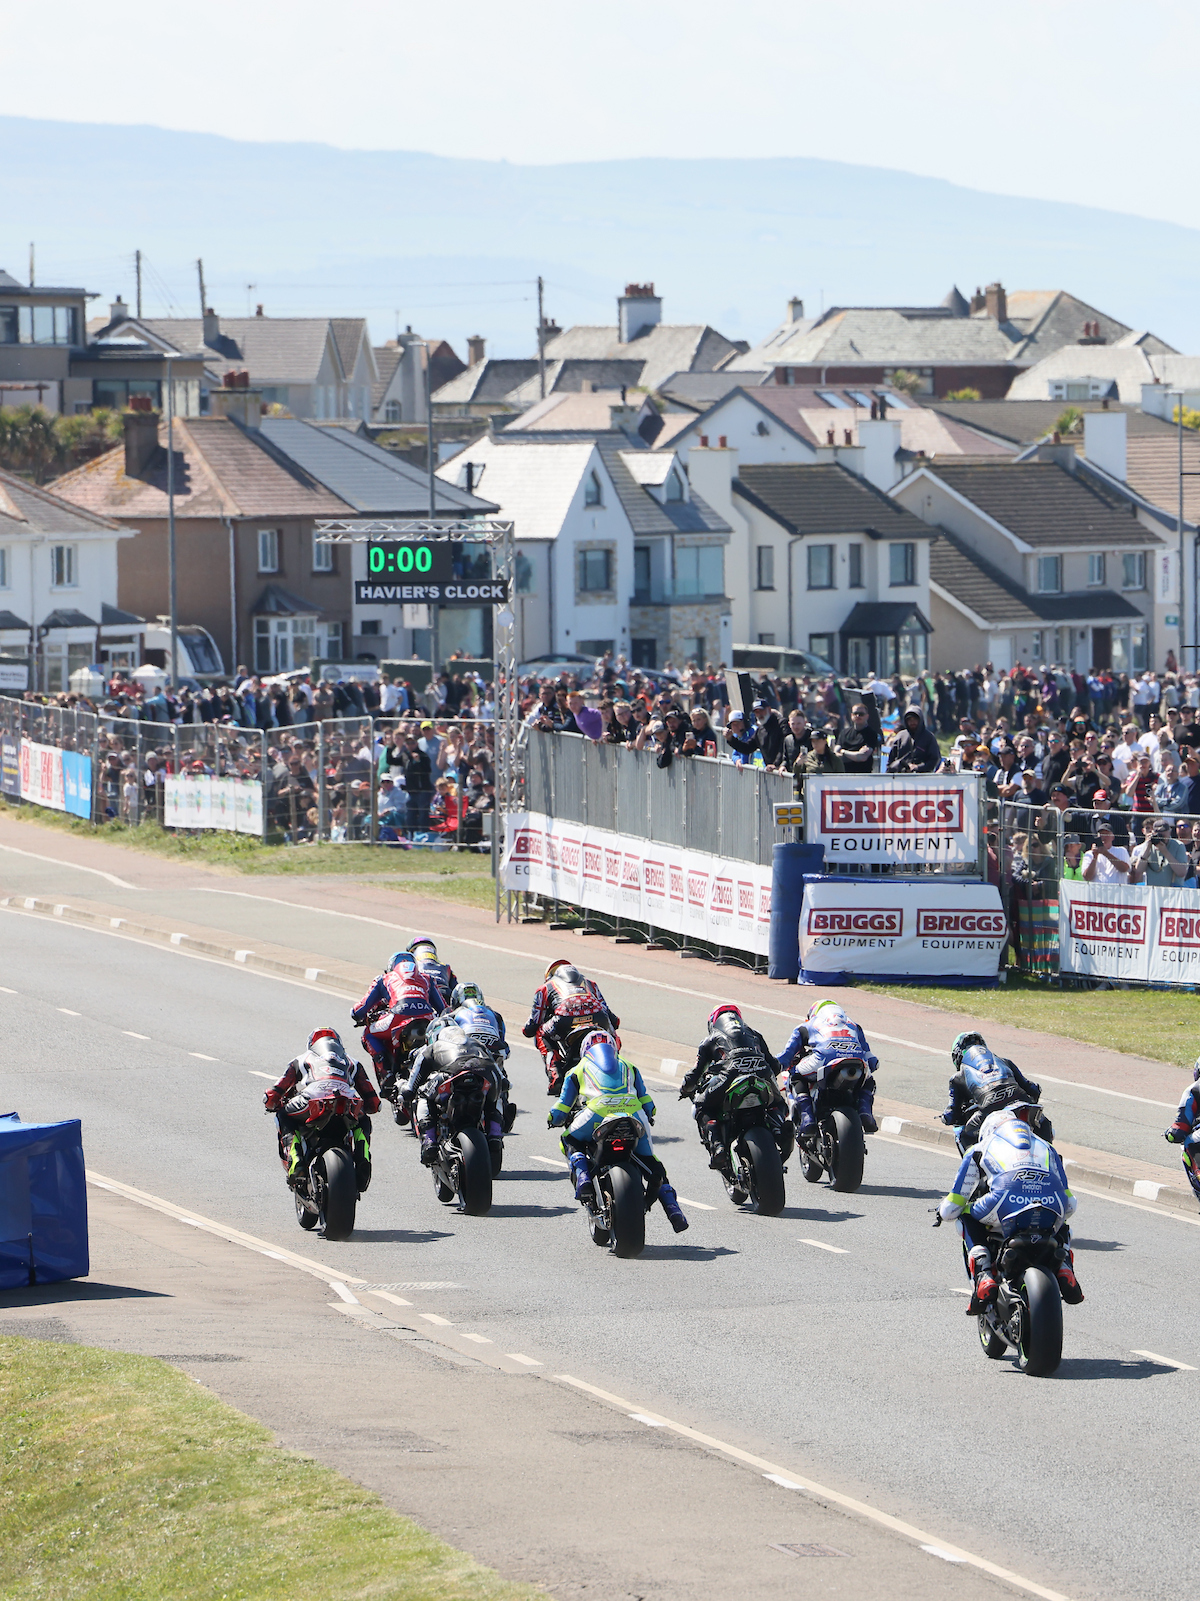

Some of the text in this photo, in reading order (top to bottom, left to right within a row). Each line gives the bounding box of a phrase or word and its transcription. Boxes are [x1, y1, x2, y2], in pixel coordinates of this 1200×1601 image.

[369, 546, 433, 573] 0:00
[360, 585, 505, 599] HAVIER'S CLOCK
[831, 800, 954, 824] BRIGGS
[830, 837, 954, 851] EQUIPMENT
[814, 914, 1004, 932] BRIGGS BRIGGS
[1074, 909, 1142, 935] BRIGGS
[813, 937, 1002, 950] EQUIPMENT EQUIPMENT
[1075, 942, 1140, 960] EQUIPMENT
[825, 1041, 861, 1050] RST
[727, 1056, 765, 1070] RST
[596, 1096, 636, 1106] RST
[1011, 1169, 1050, 1181] RST
[1009, 1194, 1055, 1205] CONROD
